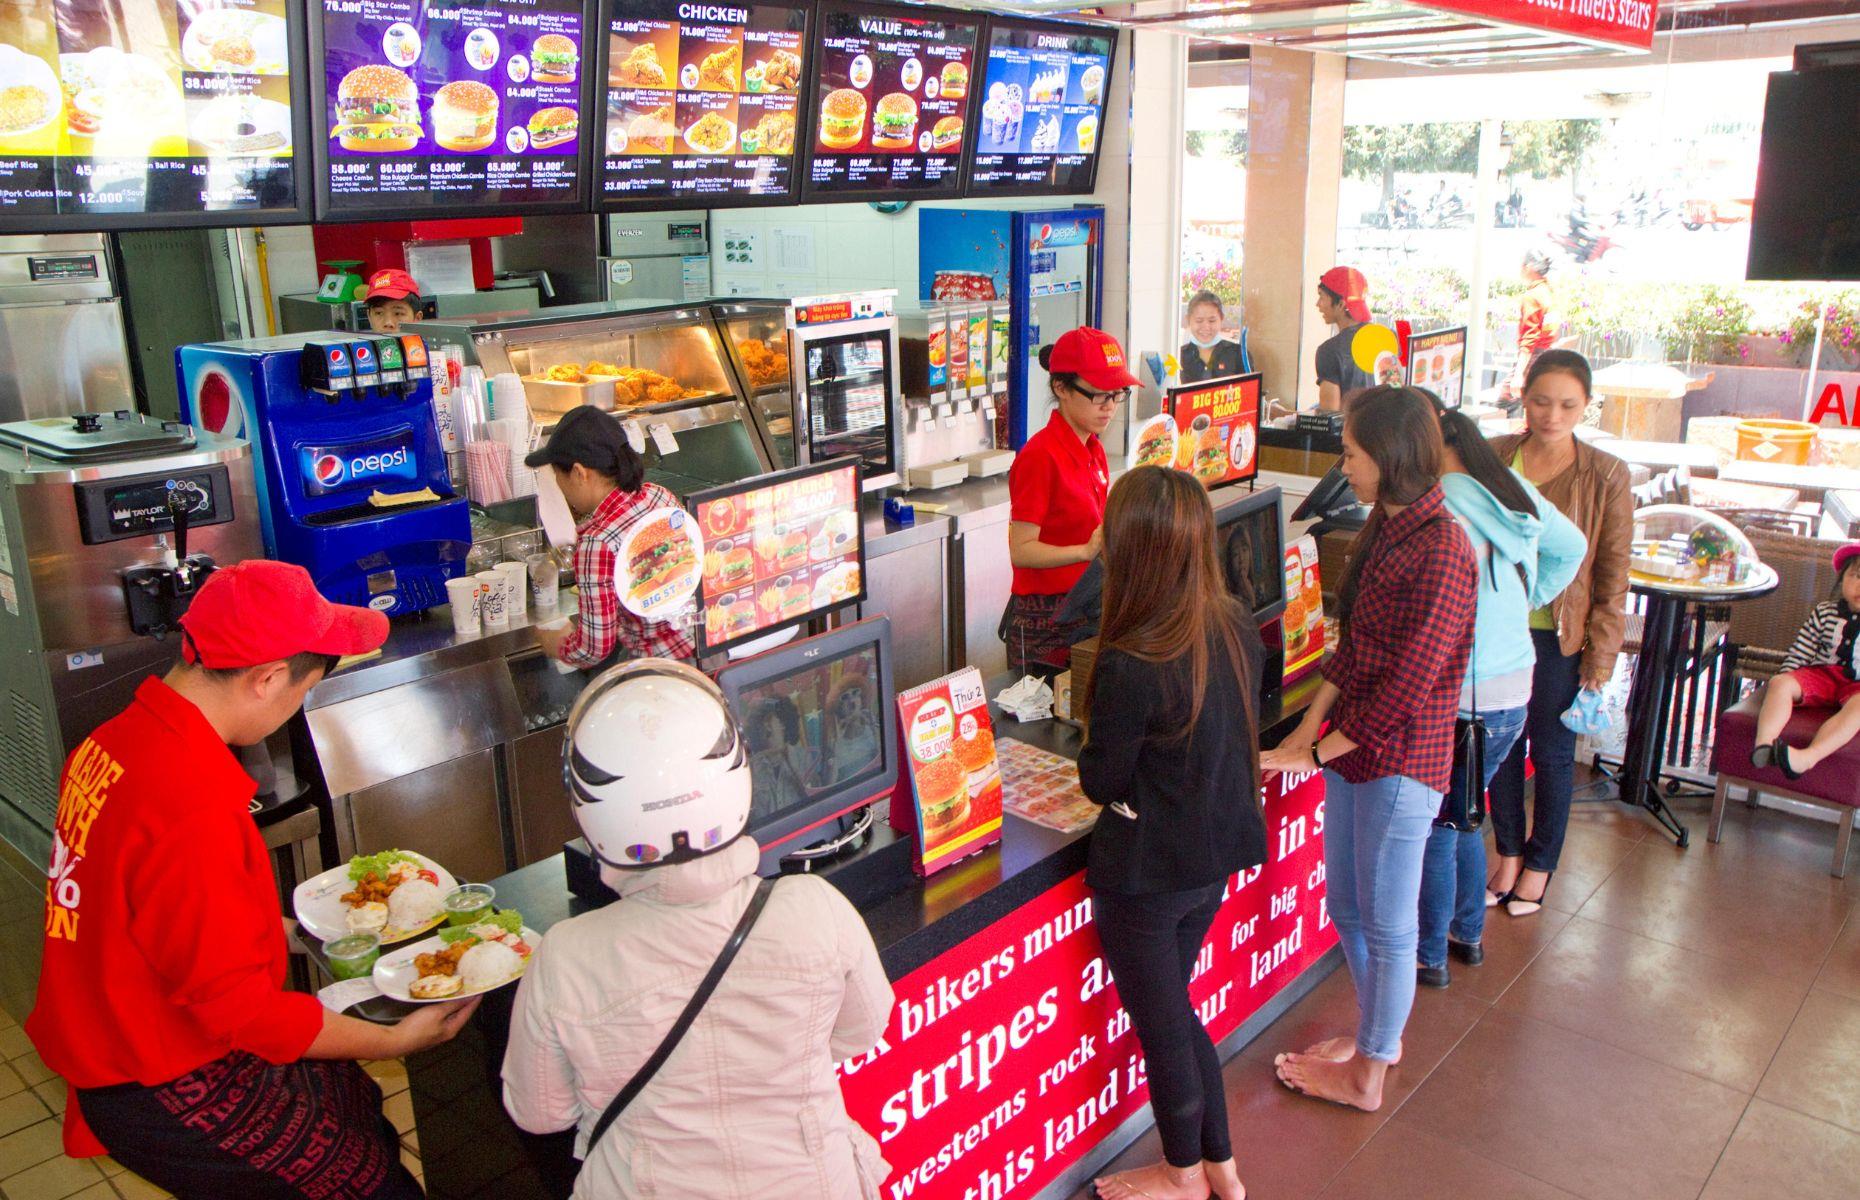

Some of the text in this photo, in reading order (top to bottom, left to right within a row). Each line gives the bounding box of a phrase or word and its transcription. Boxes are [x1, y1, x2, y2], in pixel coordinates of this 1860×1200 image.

[679, 4, 747, 23] CHICKEN
[1618, 1, 1652, 30] stars
[860, 19, 902, 36] VALUE
[1038, 35, 1069, 49] DRINK
[20, 161, 39, 169] Rice
[171, 161, 185, 169] Rice
[4, 189, 22, 198] Pork
[1193, 393, 1211, 410] BIG
[351, 446, 407, 477] pepsi
[132, 505, 164, 517] TAYLOR
[642, 593, 661, 609] BIG
[975, 686, 982, 697] 2
[68, 736, 125, 811] MADE
[1277, 815, 1306, 863] in
[1189, 942, 1213, 984] oll
[1230, 914, 1260, 953] for
[1270, 884, 1298, 922] big
[1307, 860, 1327, 894] ch
[899, 945, 1016, 1043] bikers
[1023, 896, 1094, 964] mun
[1194, 914, 1304, 1028] ur land
[880, 957, 1115, 1144] stripes a
[890, 1007, 1131, 1200] westerns rock th
[964, 1145, 1035, 1200] this
[1043, 1066, 1119, 1162] land
